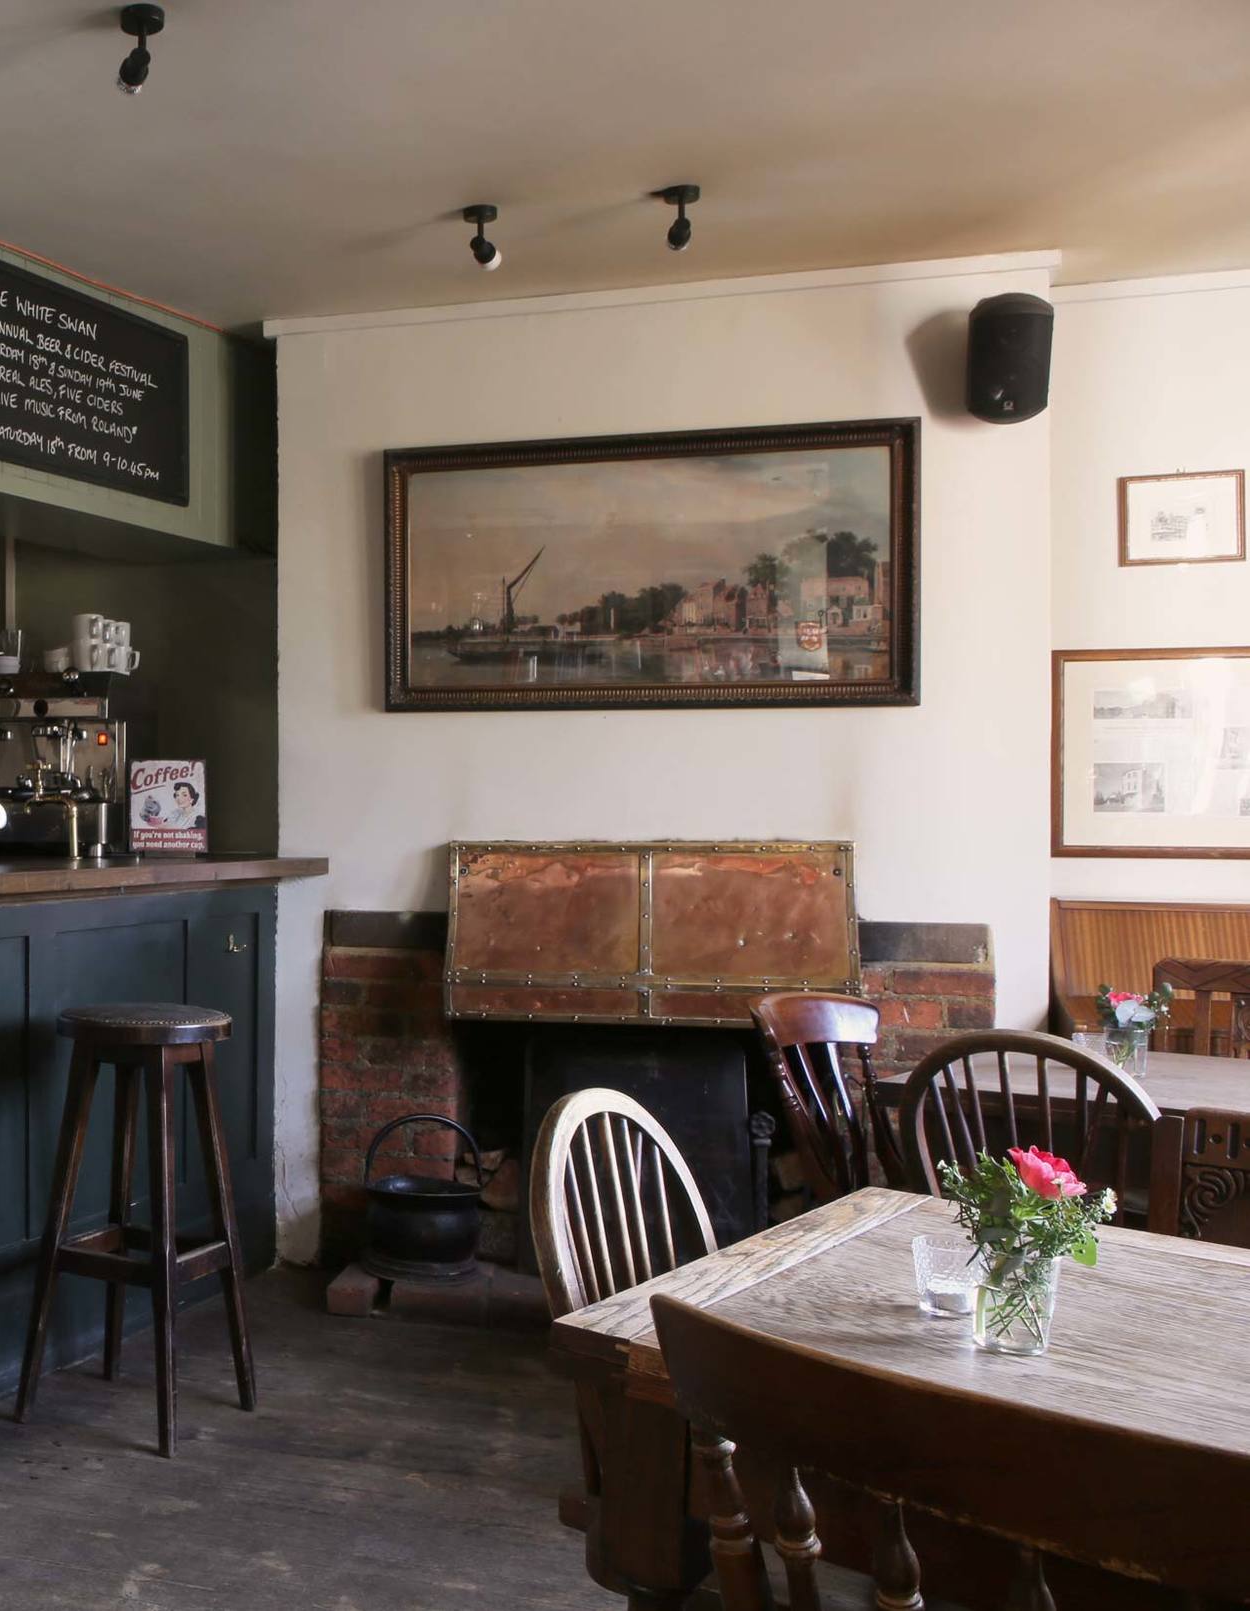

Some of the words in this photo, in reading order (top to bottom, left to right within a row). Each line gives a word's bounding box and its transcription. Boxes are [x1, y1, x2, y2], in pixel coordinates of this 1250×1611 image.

[16, 296, 56, 324] WHITE
[57, 313, 97, 341] SWAN
[36, 333, 63, 355] BEER
[74, 347, 106, 372] CIDER
[109, 360, 158, 388] FESTIVAL
[56, 365, 93, 387] SUNDAY
[95, 377, 116, 393] 19th
[119, 383, 145, 401] JUNE
[24, 399, 55, 418] MUSIC
[57, 406, 87, 430] FROM
[58, 384, 83, 403] FIVE
[86, 394, 124, 416] CIDERS
[67, 443, 97, 465] FROM
[130, 760, 196, 791] Coffee!
